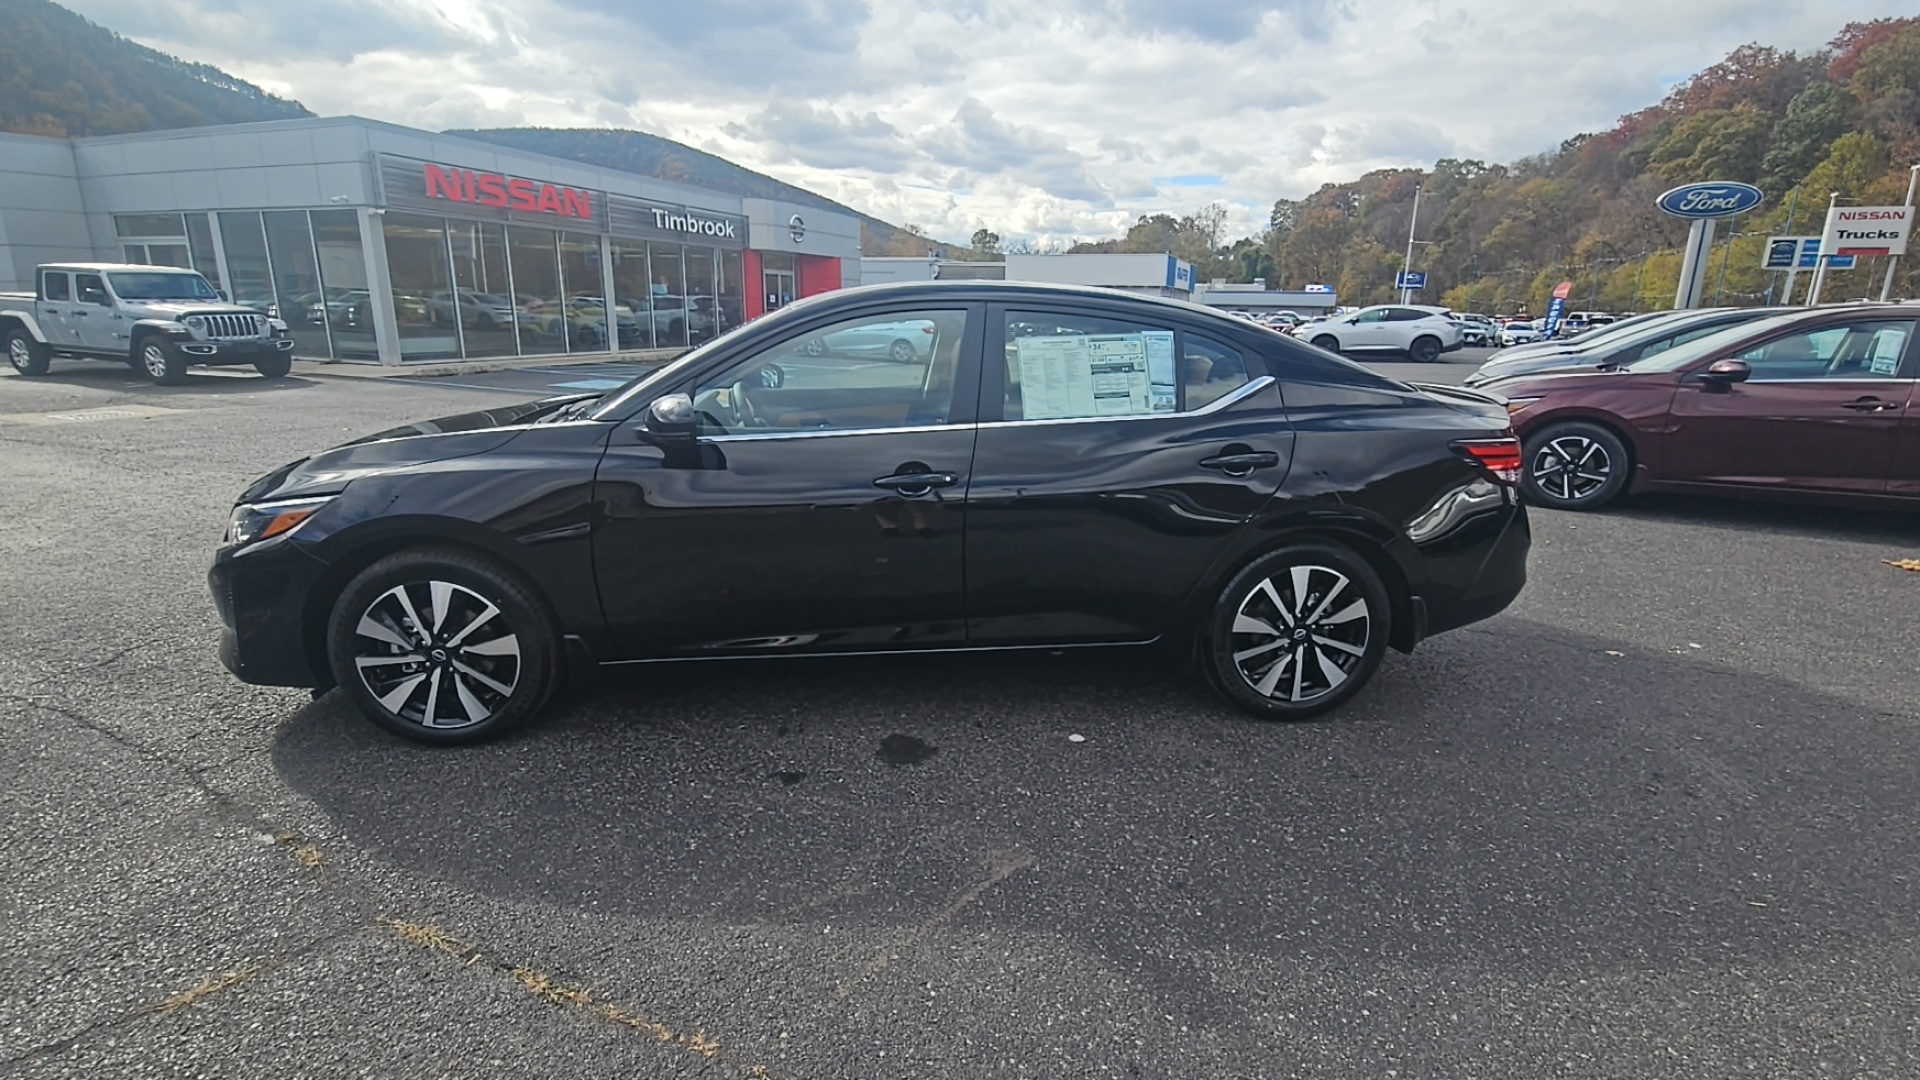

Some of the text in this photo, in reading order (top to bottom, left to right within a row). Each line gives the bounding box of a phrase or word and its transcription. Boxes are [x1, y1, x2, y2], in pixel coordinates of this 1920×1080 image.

[425, 163, 591, 219] NISSAN
[1680, 189, 1742, 211] Ford
[651, 207, 735, 238] Timbrook
[1838, 211, 1906, 221] NISSAN
[1837, 229, 1900, 240] Trucks
